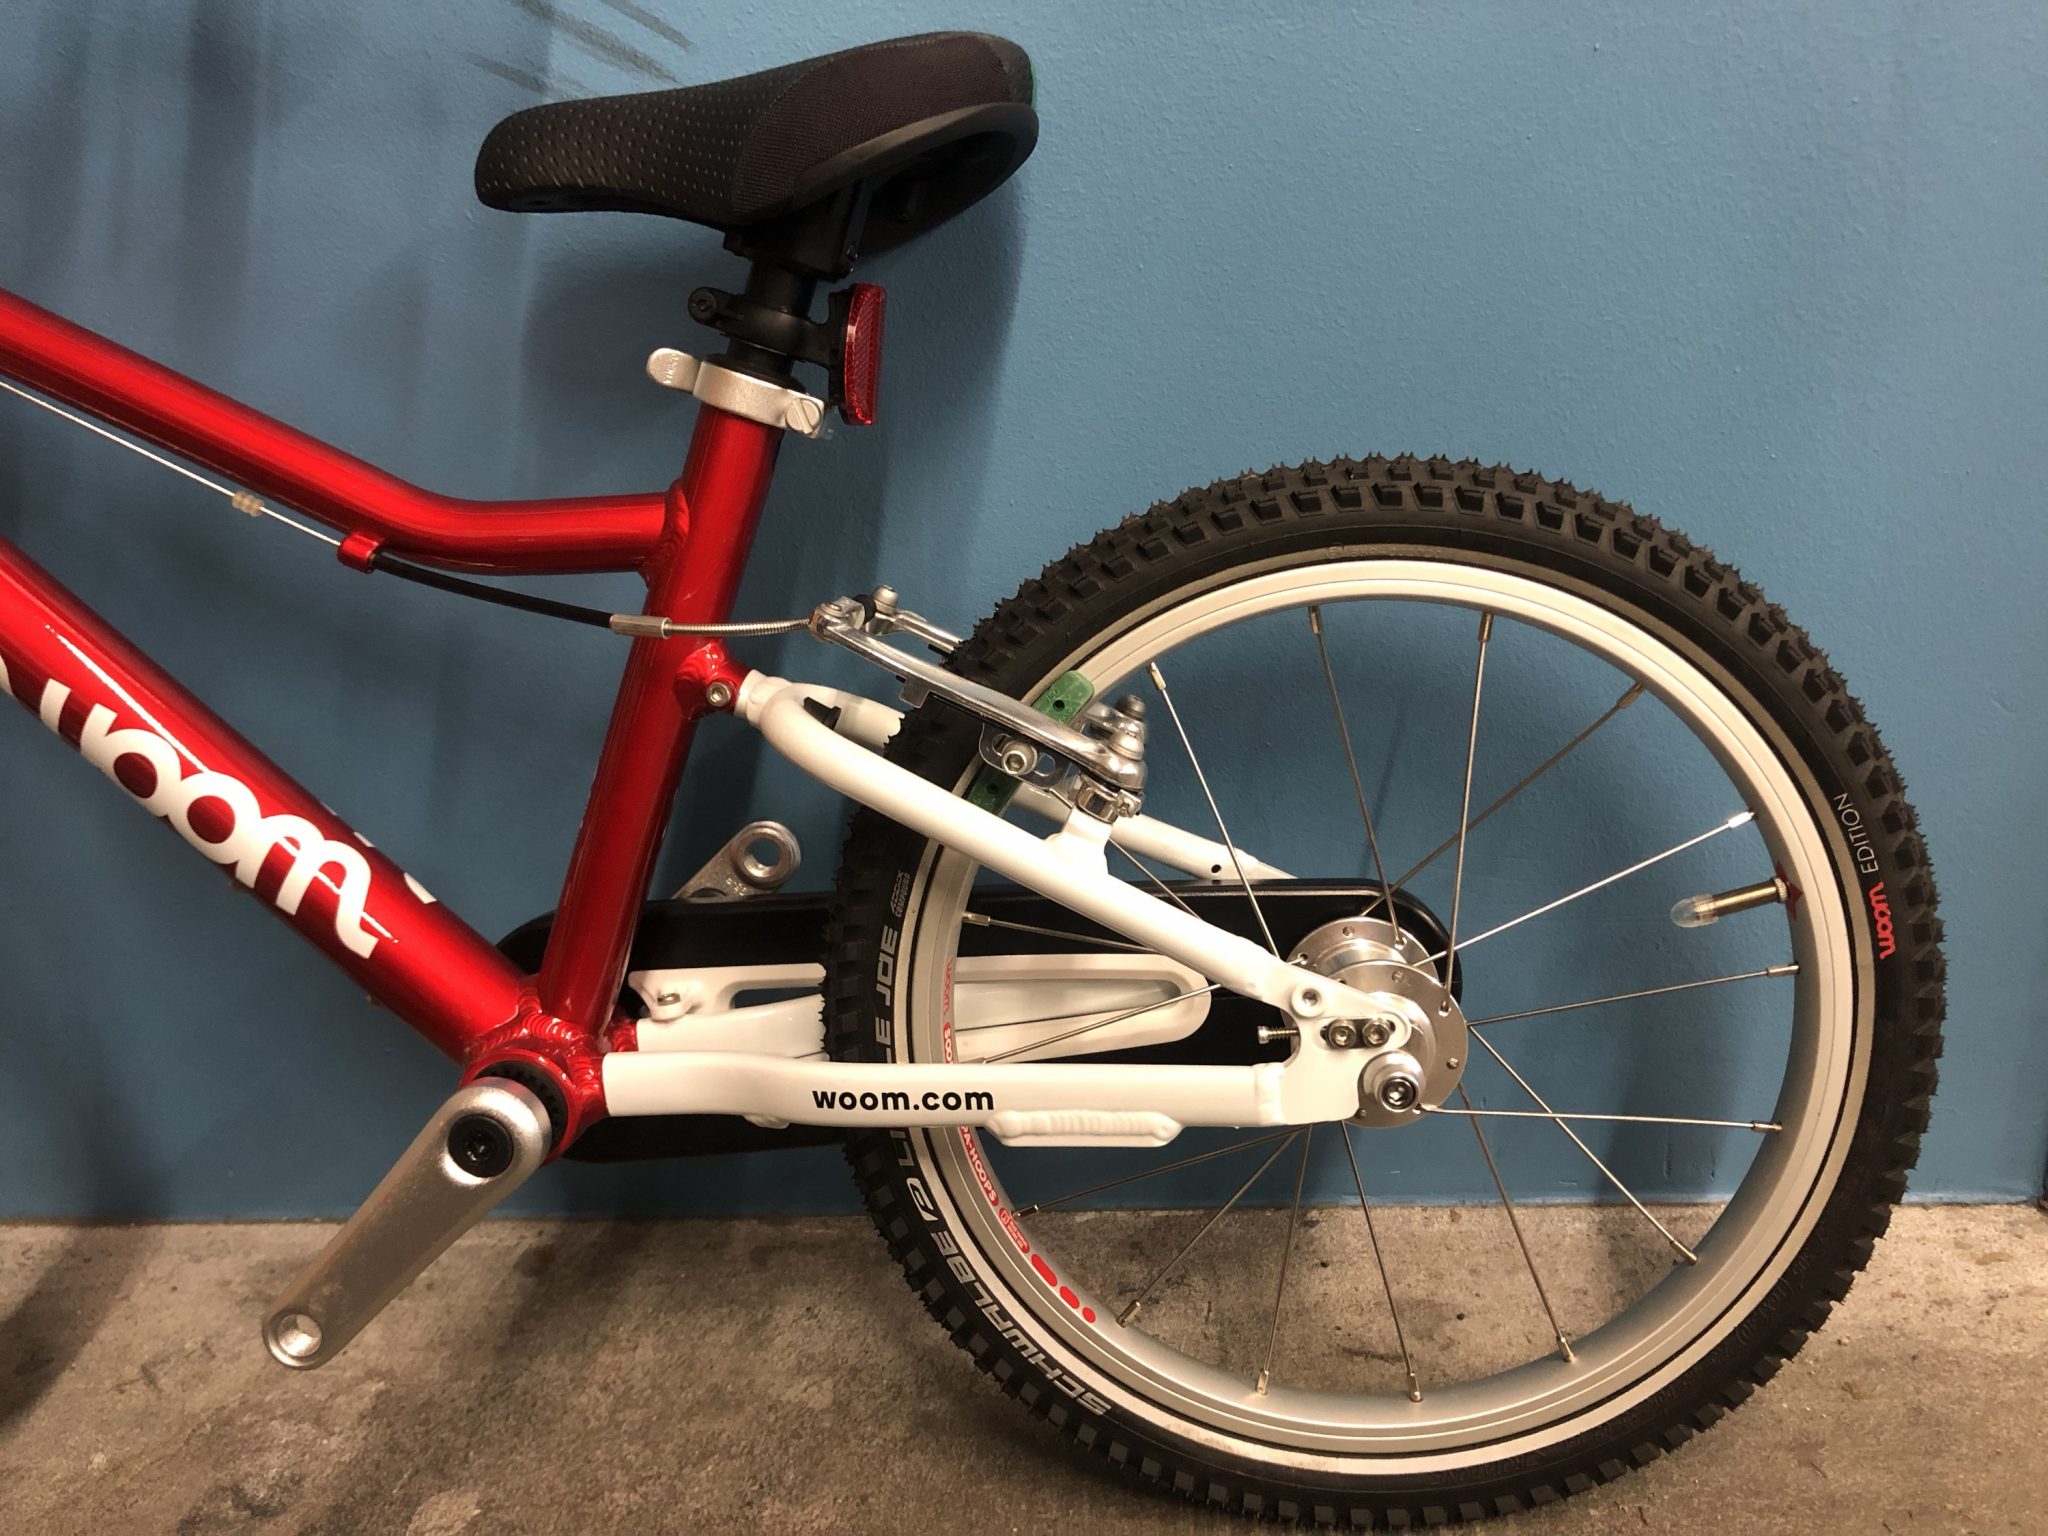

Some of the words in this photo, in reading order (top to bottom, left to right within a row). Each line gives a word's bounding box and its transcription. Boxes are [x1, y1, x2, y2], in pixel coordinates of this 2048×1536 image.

[1833, 792, 1879, 874] EDITION
[1868, 881, 1896, 960] woom
[875, 925, 898, 1007] JOE
[812, 1090, 995, 1112] woom.com
[930, 1230, 1112, 1416] SCHWALBE
